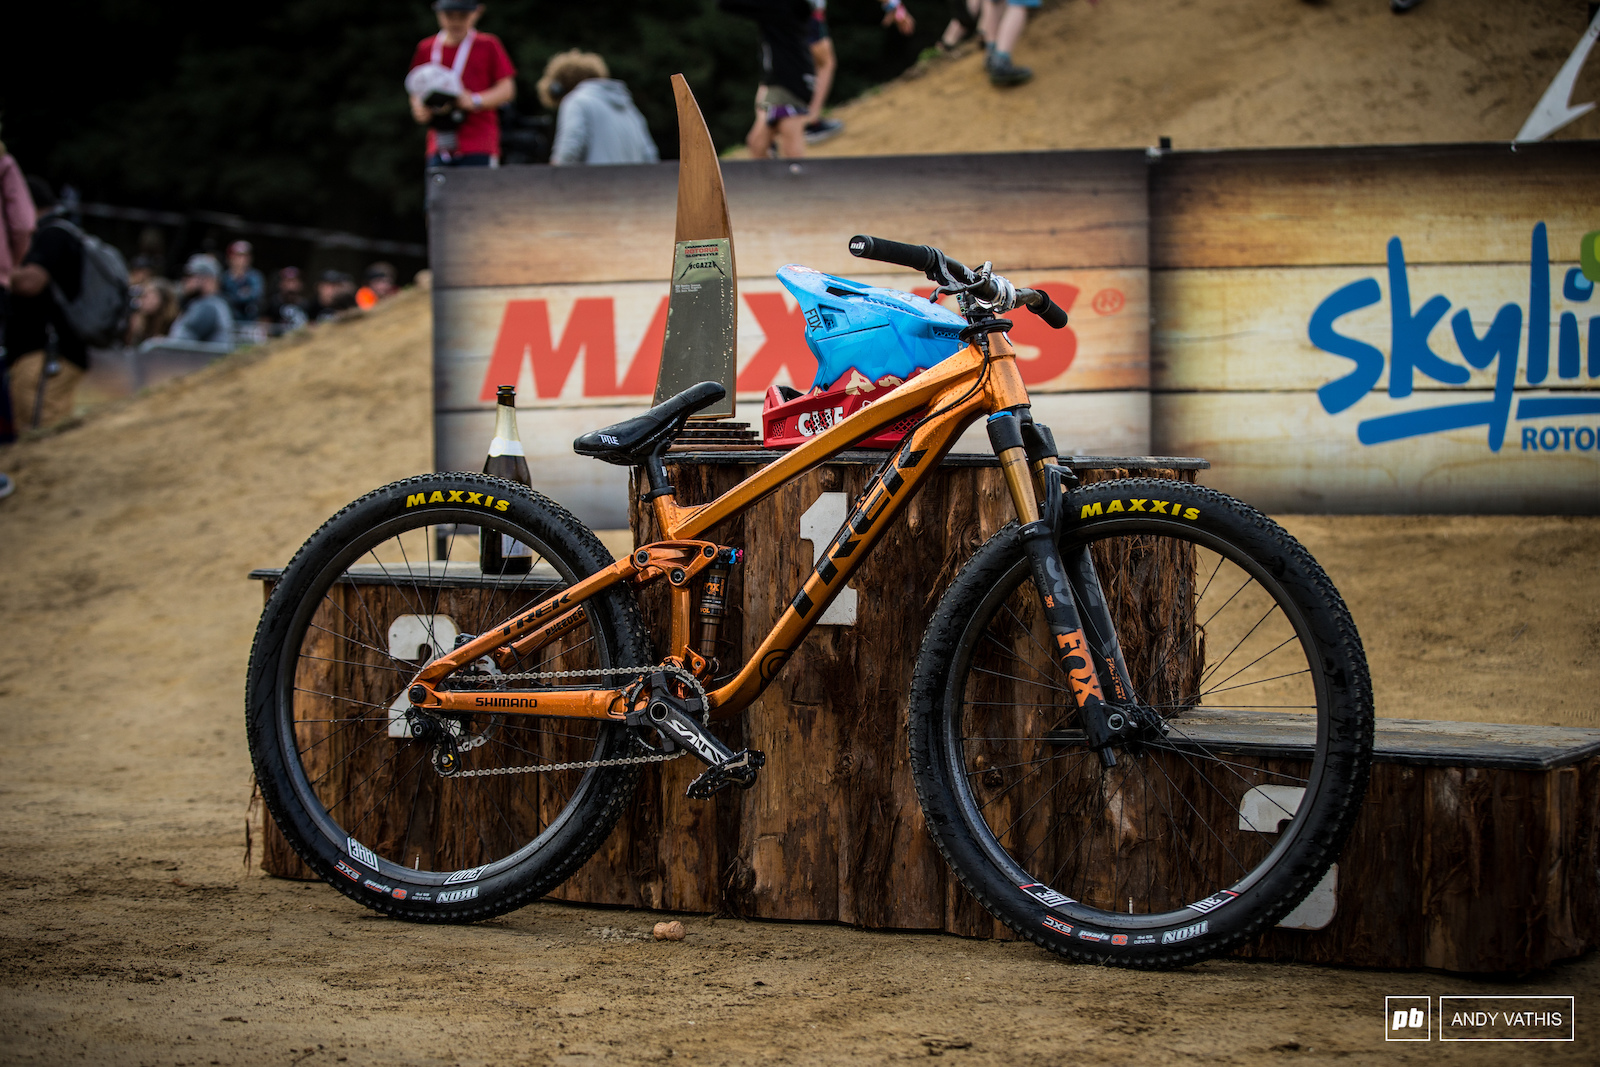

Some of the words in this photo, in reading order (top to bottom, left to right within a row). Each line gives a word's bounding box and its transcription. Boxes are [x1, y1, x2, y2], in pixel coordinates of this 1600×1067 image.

[684, 247, 719, 255] ROTORUA
[804, 308, 824, 332] FOX
[479, 281, 1080, 401] MXS
[598, 433, 620, 446] TITLE
[1521, 426, 1600, 451] ROTO
[405, 490, 511, 512] MAXXIS
[1080, 498, 1201, 521] MAXXIS
[792, 435, 929, 620] TREK
[799, 491, 858, 626] 1
[1044, 594, 1055, 608] 36
[497, 591, 572, 637] TREK
[1056, 628, 1105, 708] FOX
[475, 697, 538, 708] SHIMANO
[436, 885, 480, 904] IKON
[1161, 920, 1209, 945] IKON
